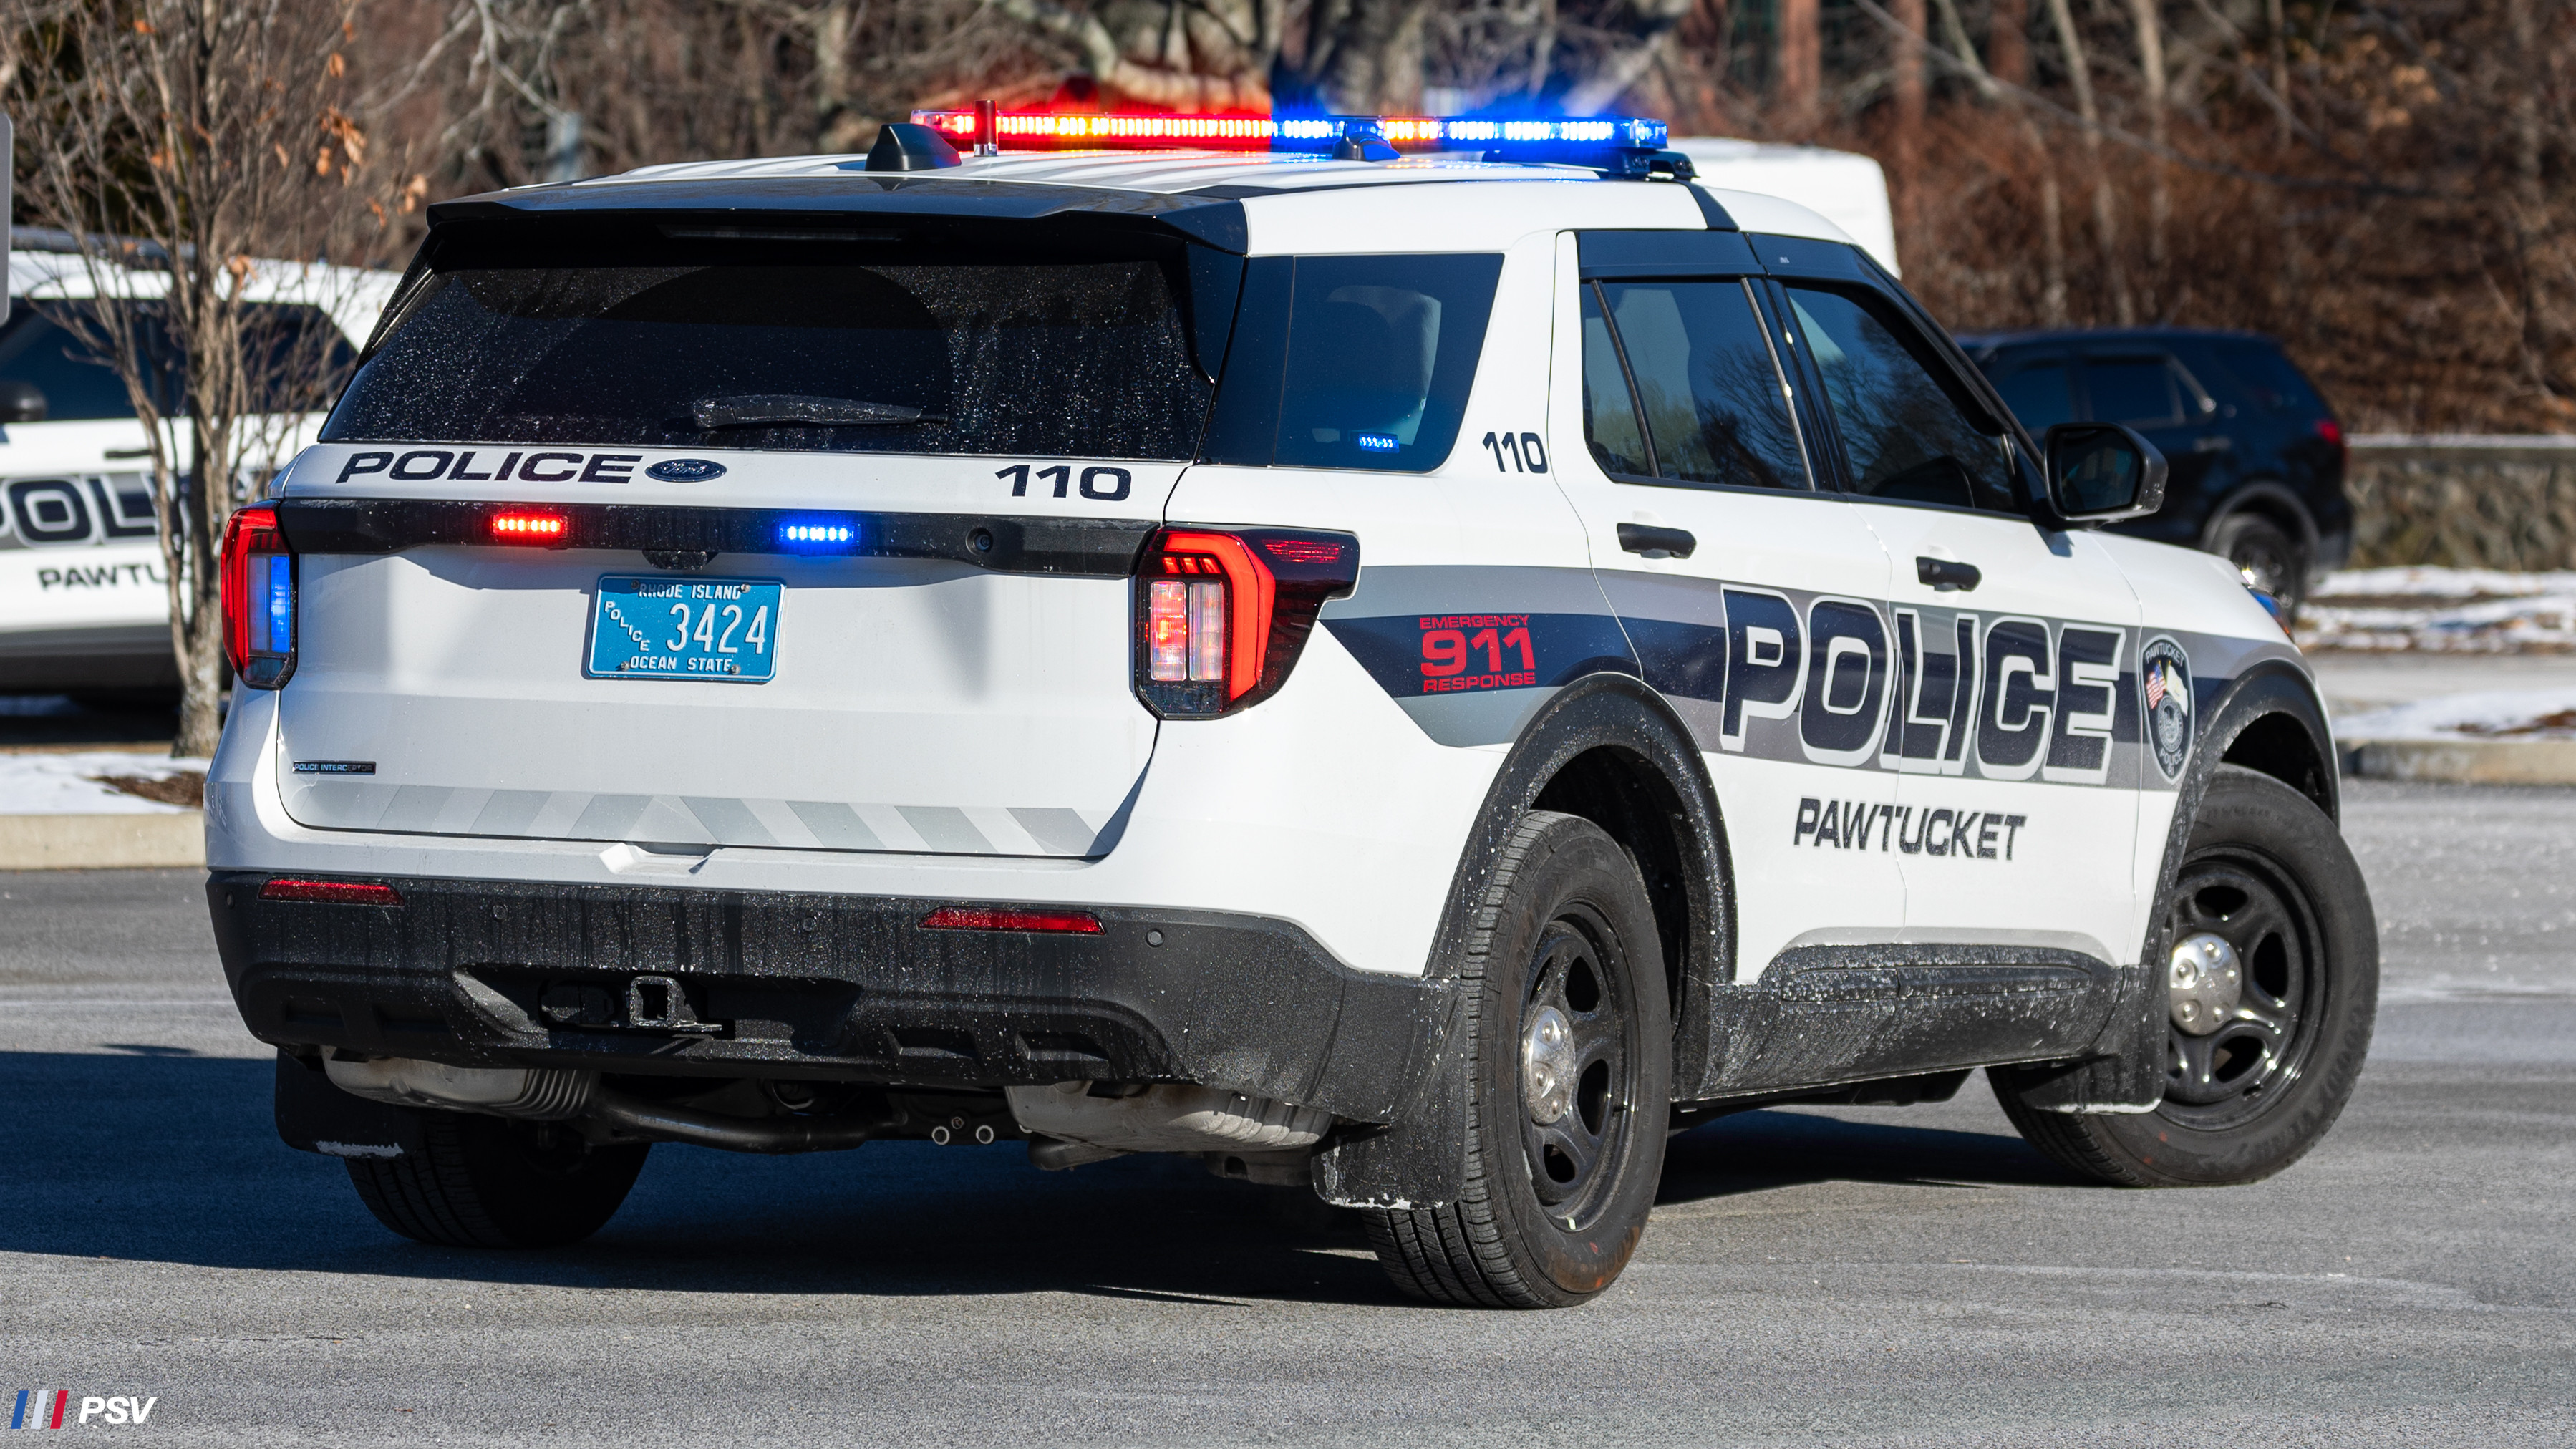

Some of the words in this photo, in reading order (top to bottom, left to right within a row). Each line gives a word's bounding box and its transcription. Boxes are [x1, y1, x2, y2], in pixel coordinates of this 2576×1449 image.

[335, 450, 644, 484] POLICE
[1482, 431, 1549, 475] 110
[994, 465, 1132, 501] 110
[638, 583, 684, 598] RHODE
[691, 584, 742, 600] ISLAND
[604, 601, 651, 651] POLICE
[667, 603, 768, 654] 3424
[1420, 614, 1530, 630] EMERGENCY
[630, 656, 677, 671] OCEAN
[687, 657, 733, 672] STATE
[1420, 627, 1536, 677] 911
[2145, 641, 2185, 667] PAWTUCKET
[1423, 672, 1536, 692] RESPONSE
[1720, 583, 2128, 785] POLICE
[294, 762, 319, 771] POLICE
[320, 763, 373, 772] INTERCEPTOR
[2159, 747, 2184, 766] POLICE
[2167, 765, 2175, 776] RI
[1793, 796, 2028, 861] PAWTUCKET
